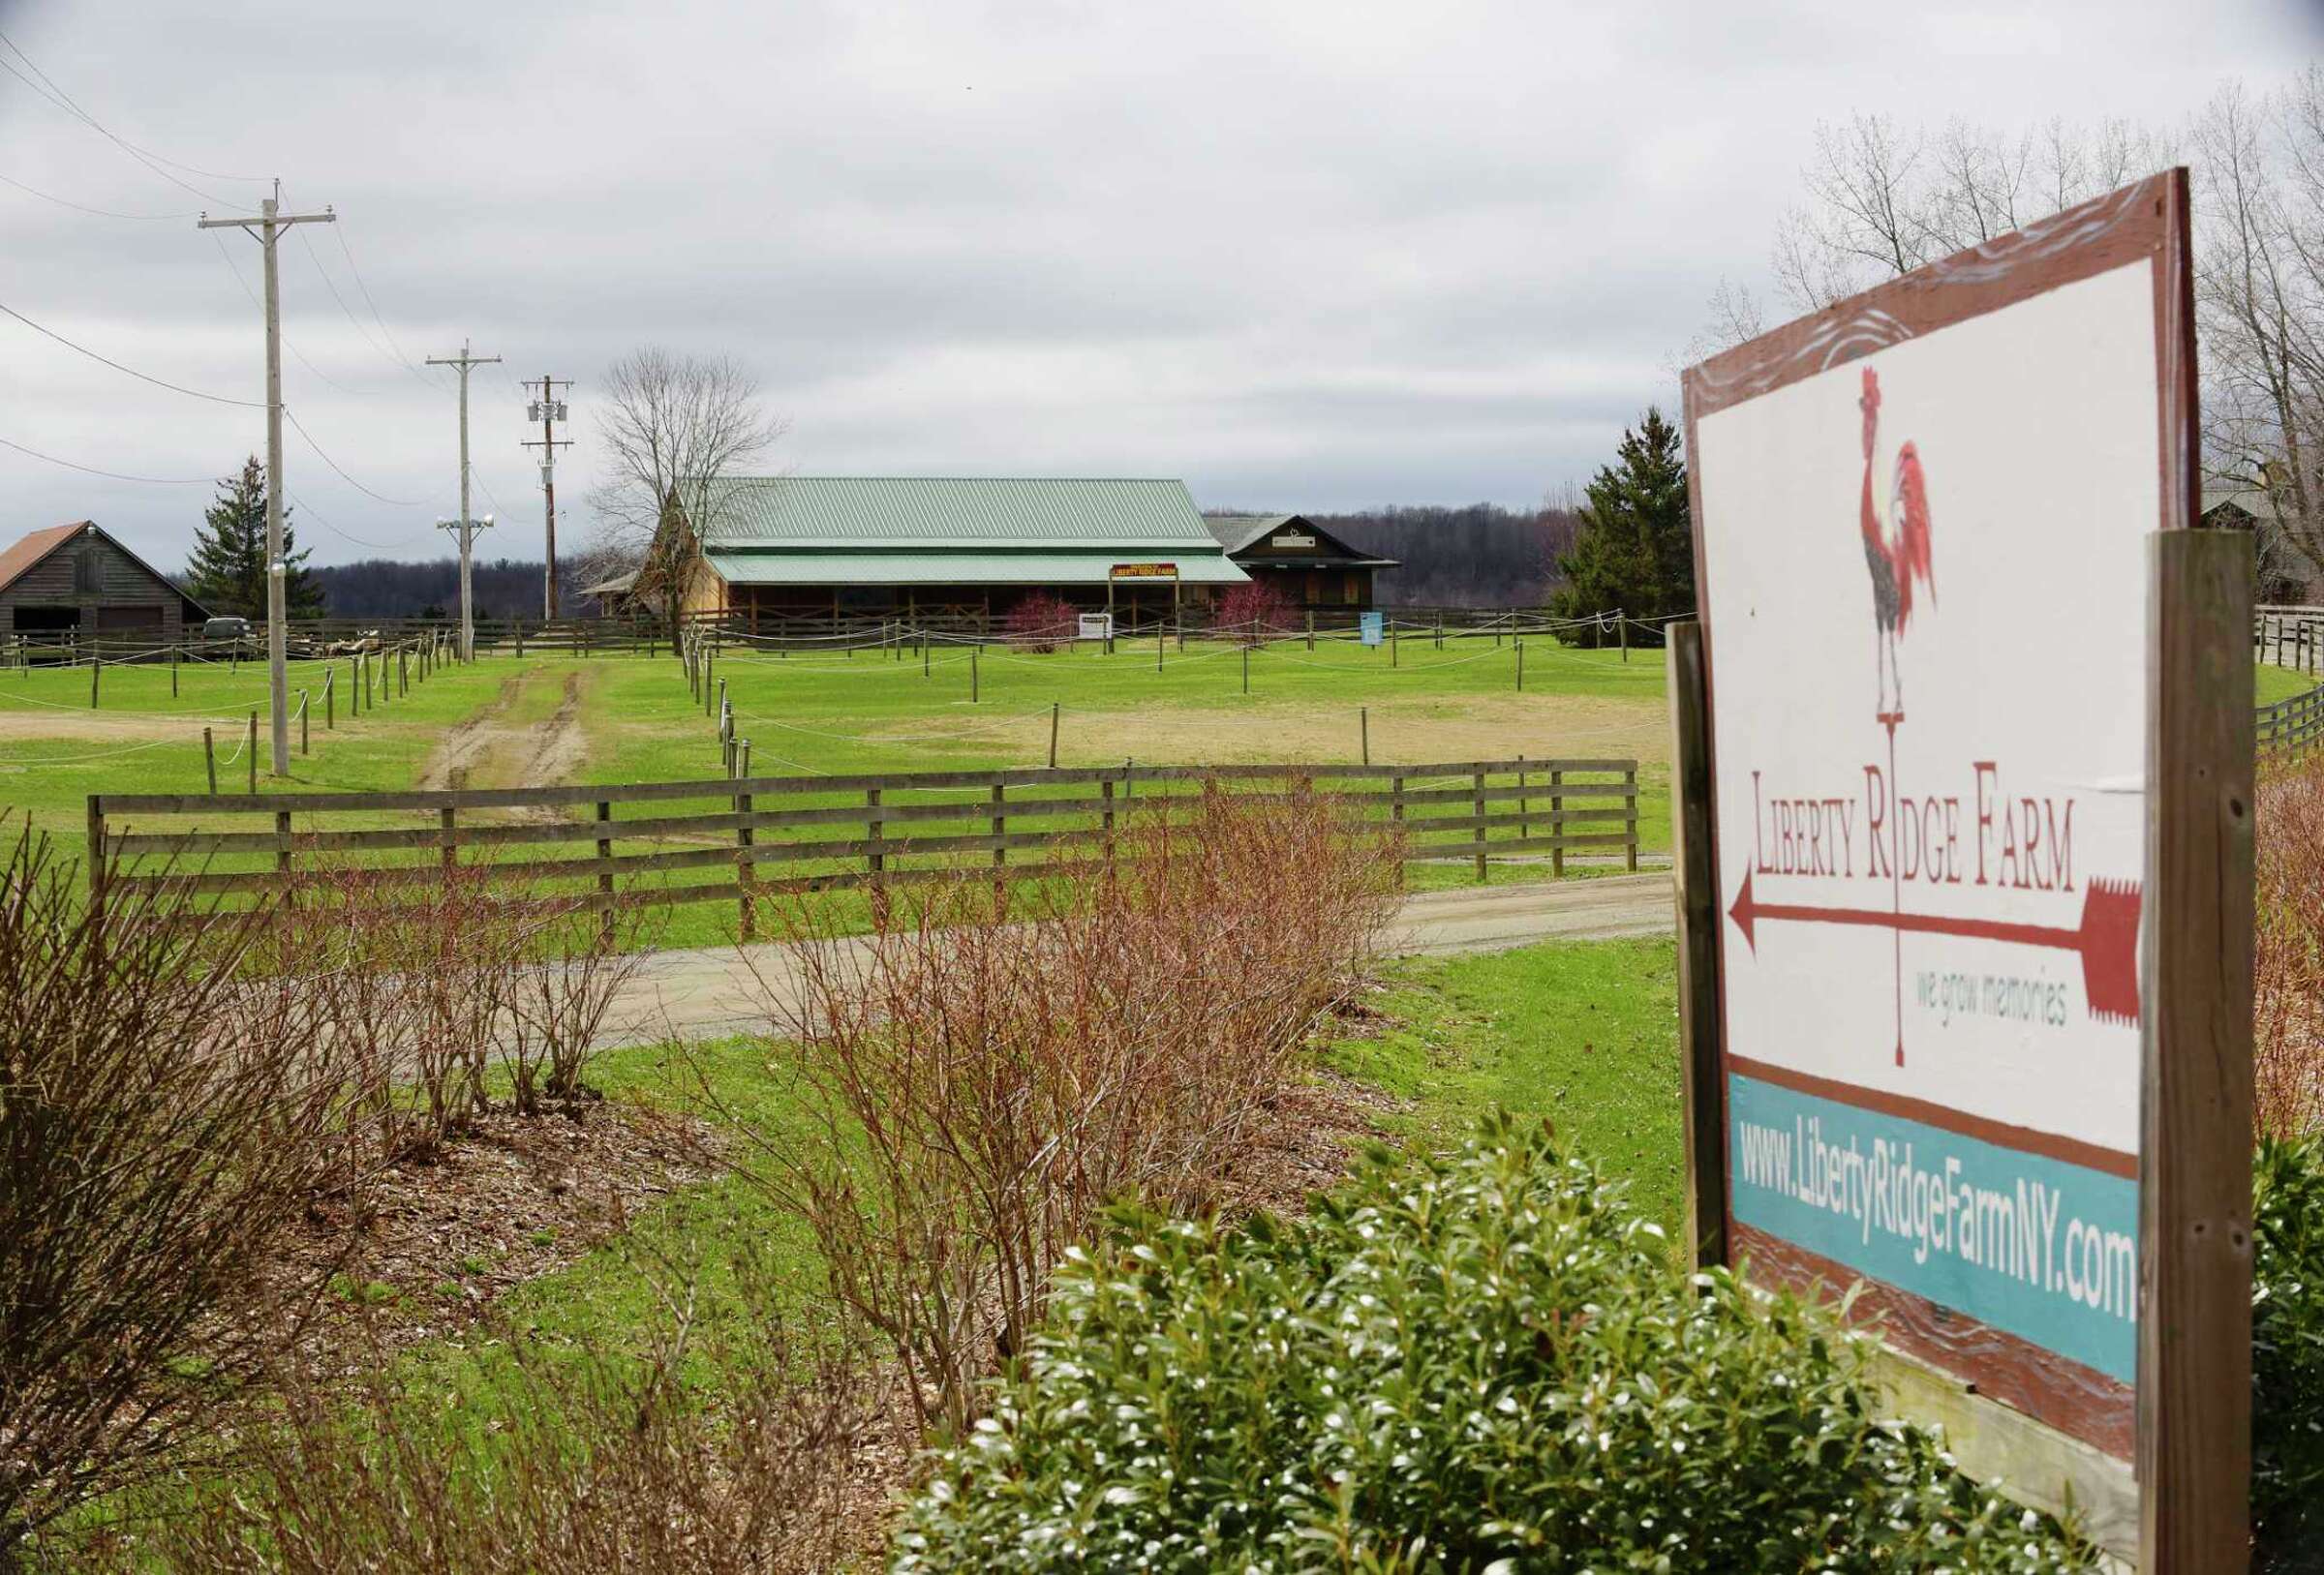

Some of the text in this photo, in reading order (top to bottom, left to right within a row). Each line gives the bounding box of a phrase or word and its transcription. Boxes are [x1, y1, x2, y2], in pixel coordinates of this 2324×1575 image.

[1752, 771, 1855, 878] LIBERTY
[1973, 761, 2074, 893] FARM
[1916, 965, 2066, 1028] we grow memories
[1740, 1114, 2136, 1322] www.LibertyRidgeFarmNY.com
